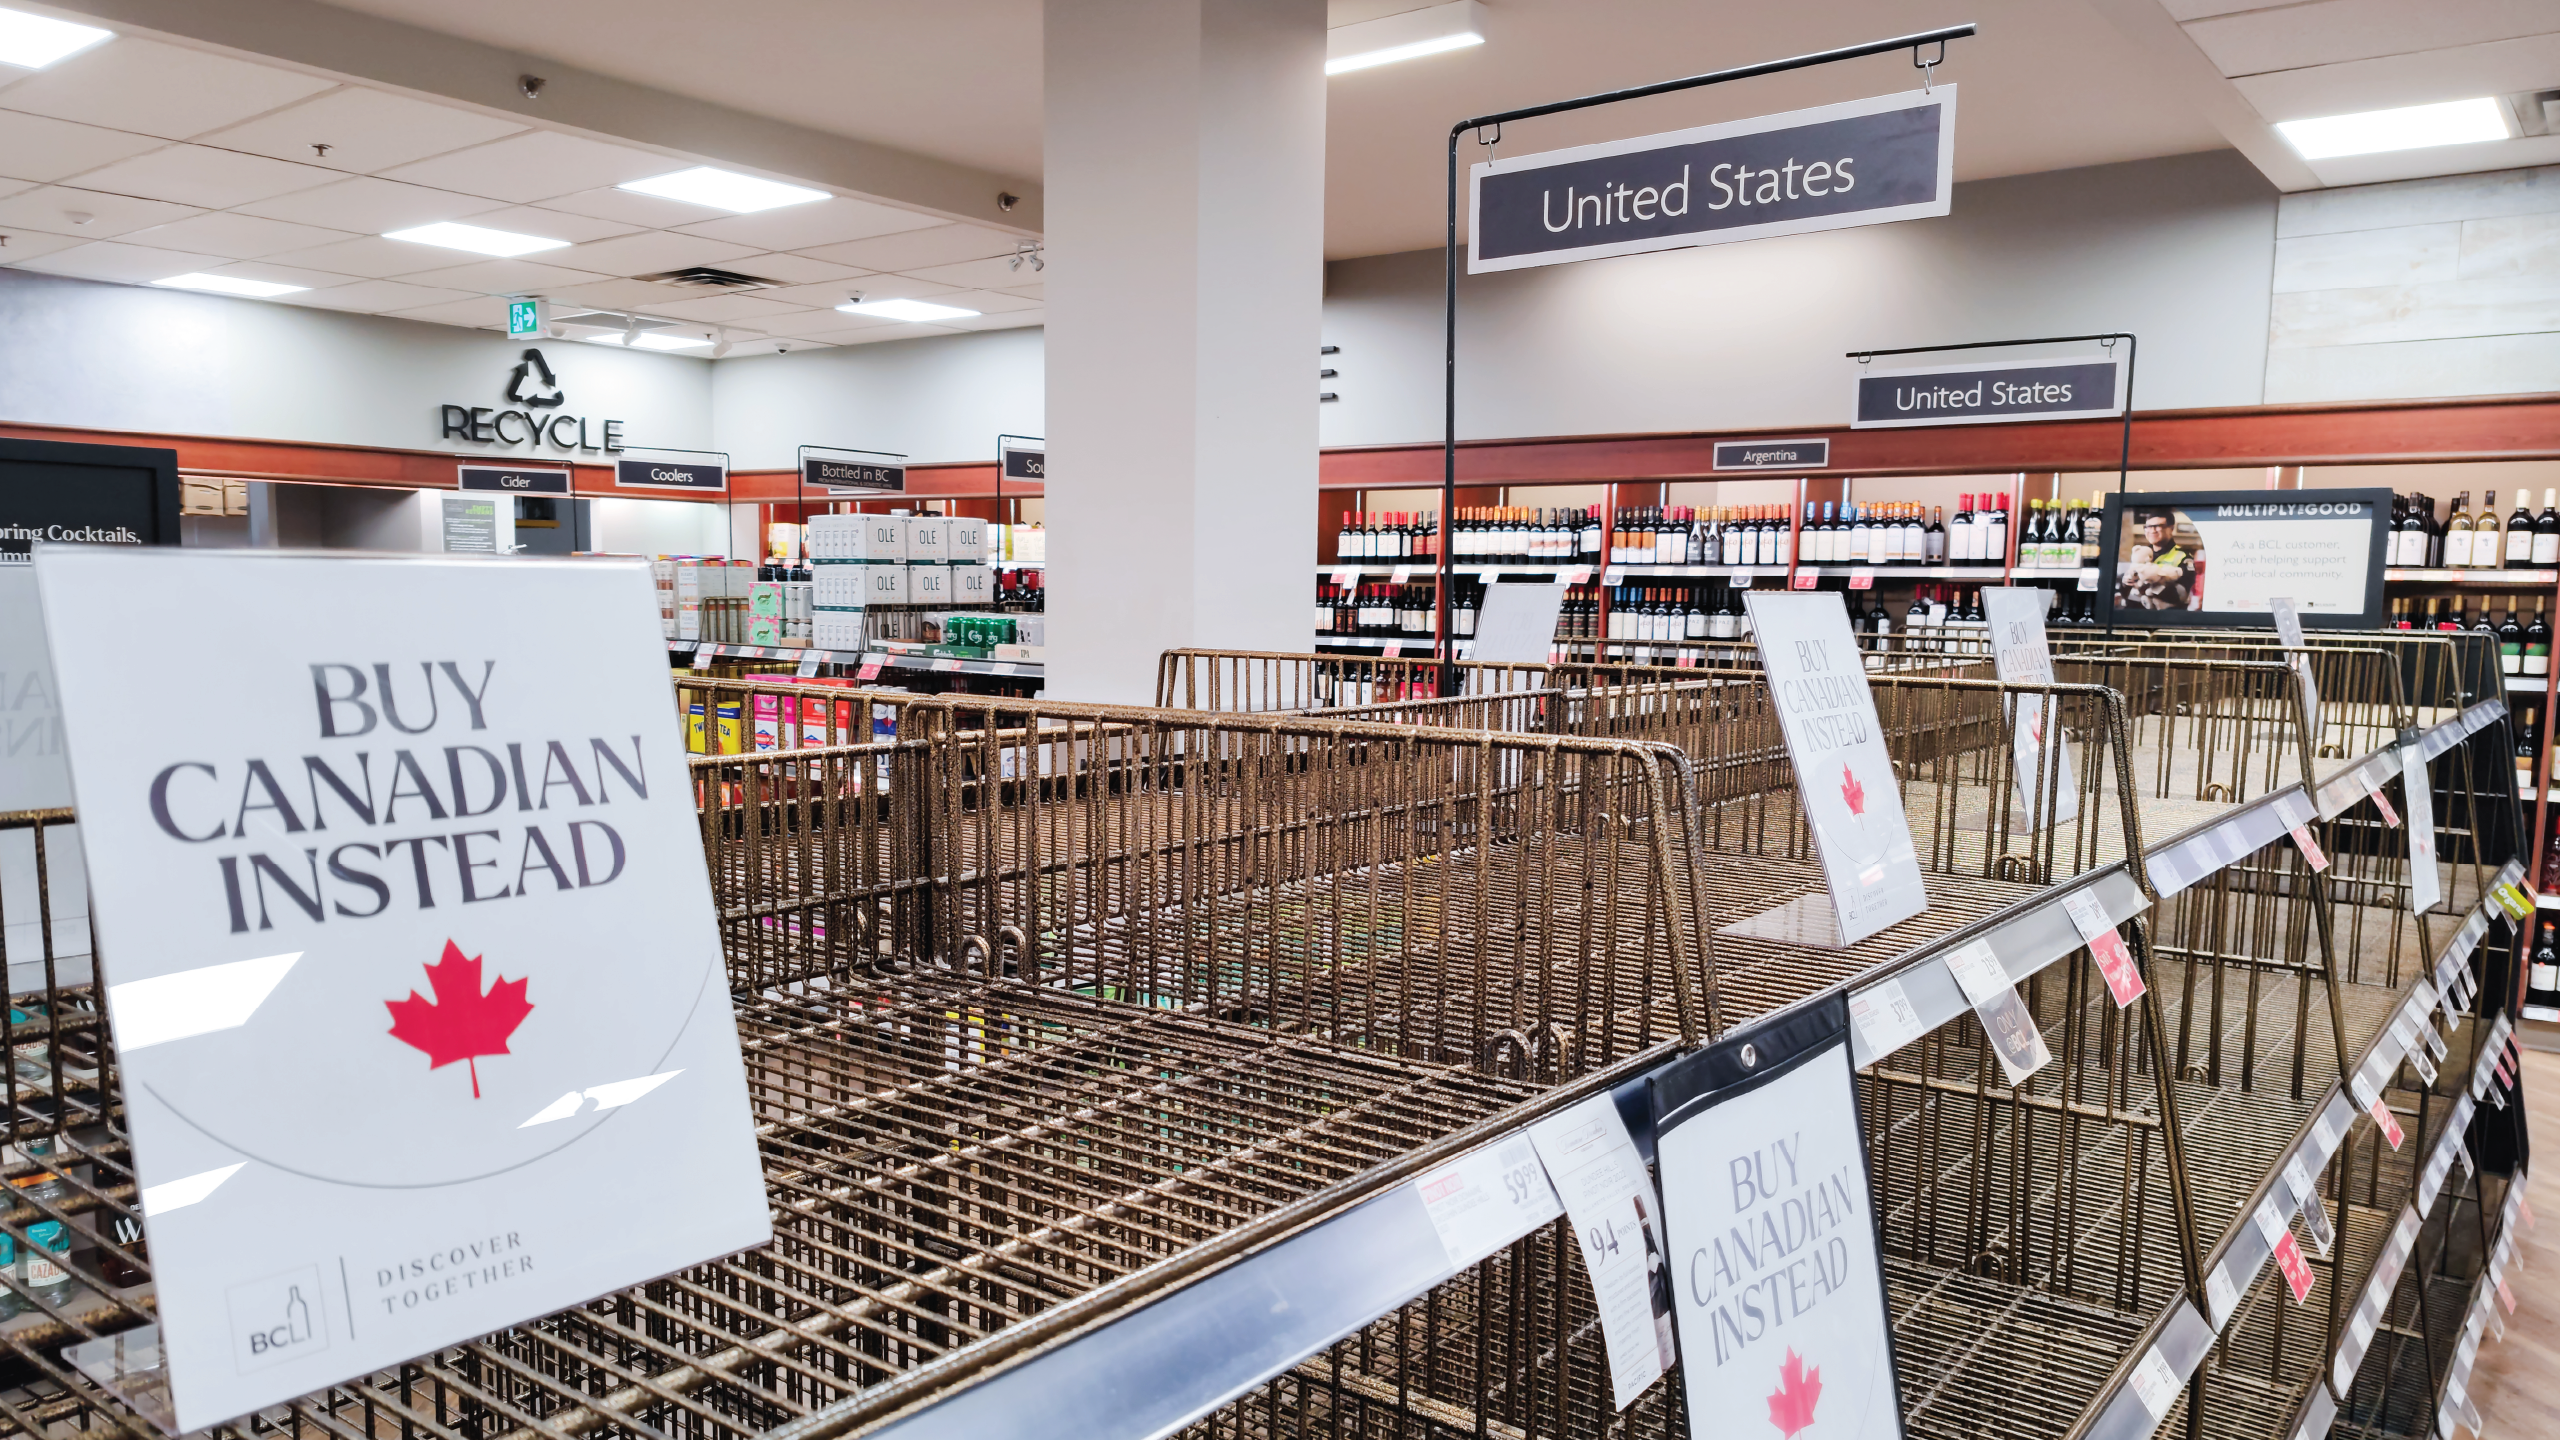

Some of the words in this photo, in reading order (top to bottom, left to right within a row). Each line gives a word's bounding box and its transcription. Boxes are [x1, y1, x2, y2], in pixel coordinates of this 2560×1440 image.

[1542, 164, 1689, 233] United
[1709, 152, 1856, 212] States
[1895, 383, 1983, 412] United
[1991, 378, 2073, 406] States
[442, 404, 625, 452] RECYCLE
[1743, 448, 1798, 466] Argentina
[500, 475, 531, 489] Cider
[651, 467, 694, 484] Coolers
[822, 464, 860, 480] Bottled
[863, 468, 873, 481] in
[875, 469, 890, 483] BC
[2217, 504, 2297, 518] MULTIPLY
[2305, 503, 2362, 516] GOOD
[47, 524, 143, 546] Cocktails,
[877, 525, 896, 543] OLÉ
[919, 527, 937, 546] OLÉ
[960, 527, 978, 545] OLÉ
[2231, 540, 2246, 550] As
[2248, 542, 2255, 550] a
[2259, 540, 2282, 550] BCL
[2285, 540, 2340, 551] customer,
[2223, 554, 2258, 567] you're
[2260, 554, 2299, 567] helping
[2302, 555, 2347, 567] support
[877, 574, 896, 591] OLÉ
[923, 574, 941, 591] OLÉ
[966, 573, 983, 590] OLÉ
[2223, 570, 2249, 580] your
[2251, 569, 2276, 579] local
[2279, 569, 2344, 580] community.
[2009, 621, 2028, 645] BUY
[1795, 638, 1830, 673] BUY
[2001, 647, 2048, 674] CANADIAN
[308, 659, 496, 740] BUY
[1783, 674, 1865, 715] CANADIAN
[719, 723, 731, 738] TEA
[1801, 711, 1868, 753] INSTEAD
[149, 735, 650, 844] CANADIAN
[217, 820, 626, 934] INSTEAD
[2497, 887, 2528, 918] Organic
[1996, 1009, 2020, 1035] ONLY
[1581, 1167, 1604, 1186] DUNDEE
[1604, 1161, 1619, 1175] HILLS
[1583, 1184, 1599, 1198] PINOT
[1599, 1177, 1613, 1190] NOIR
[1613, 1171, 1627, 1183] 2022
[1727, 1131, 1802, 1214] BUY
[1589, 1219, 1619, 1267] 94
[1617, 1220, 1637, 1238] POINTS
[1690, 1165, 1856, 1309] CANADIAN
[249, 1312, 307, 1357] BCL
[377, 1231, 523, 1289] DISCOVER
[382, 1254, 537, 1316] TOGETHER
[1709, 1236, 1850, 1368] INSTEAD
[1627, 1370, 1647, 1390] PACIFIC
